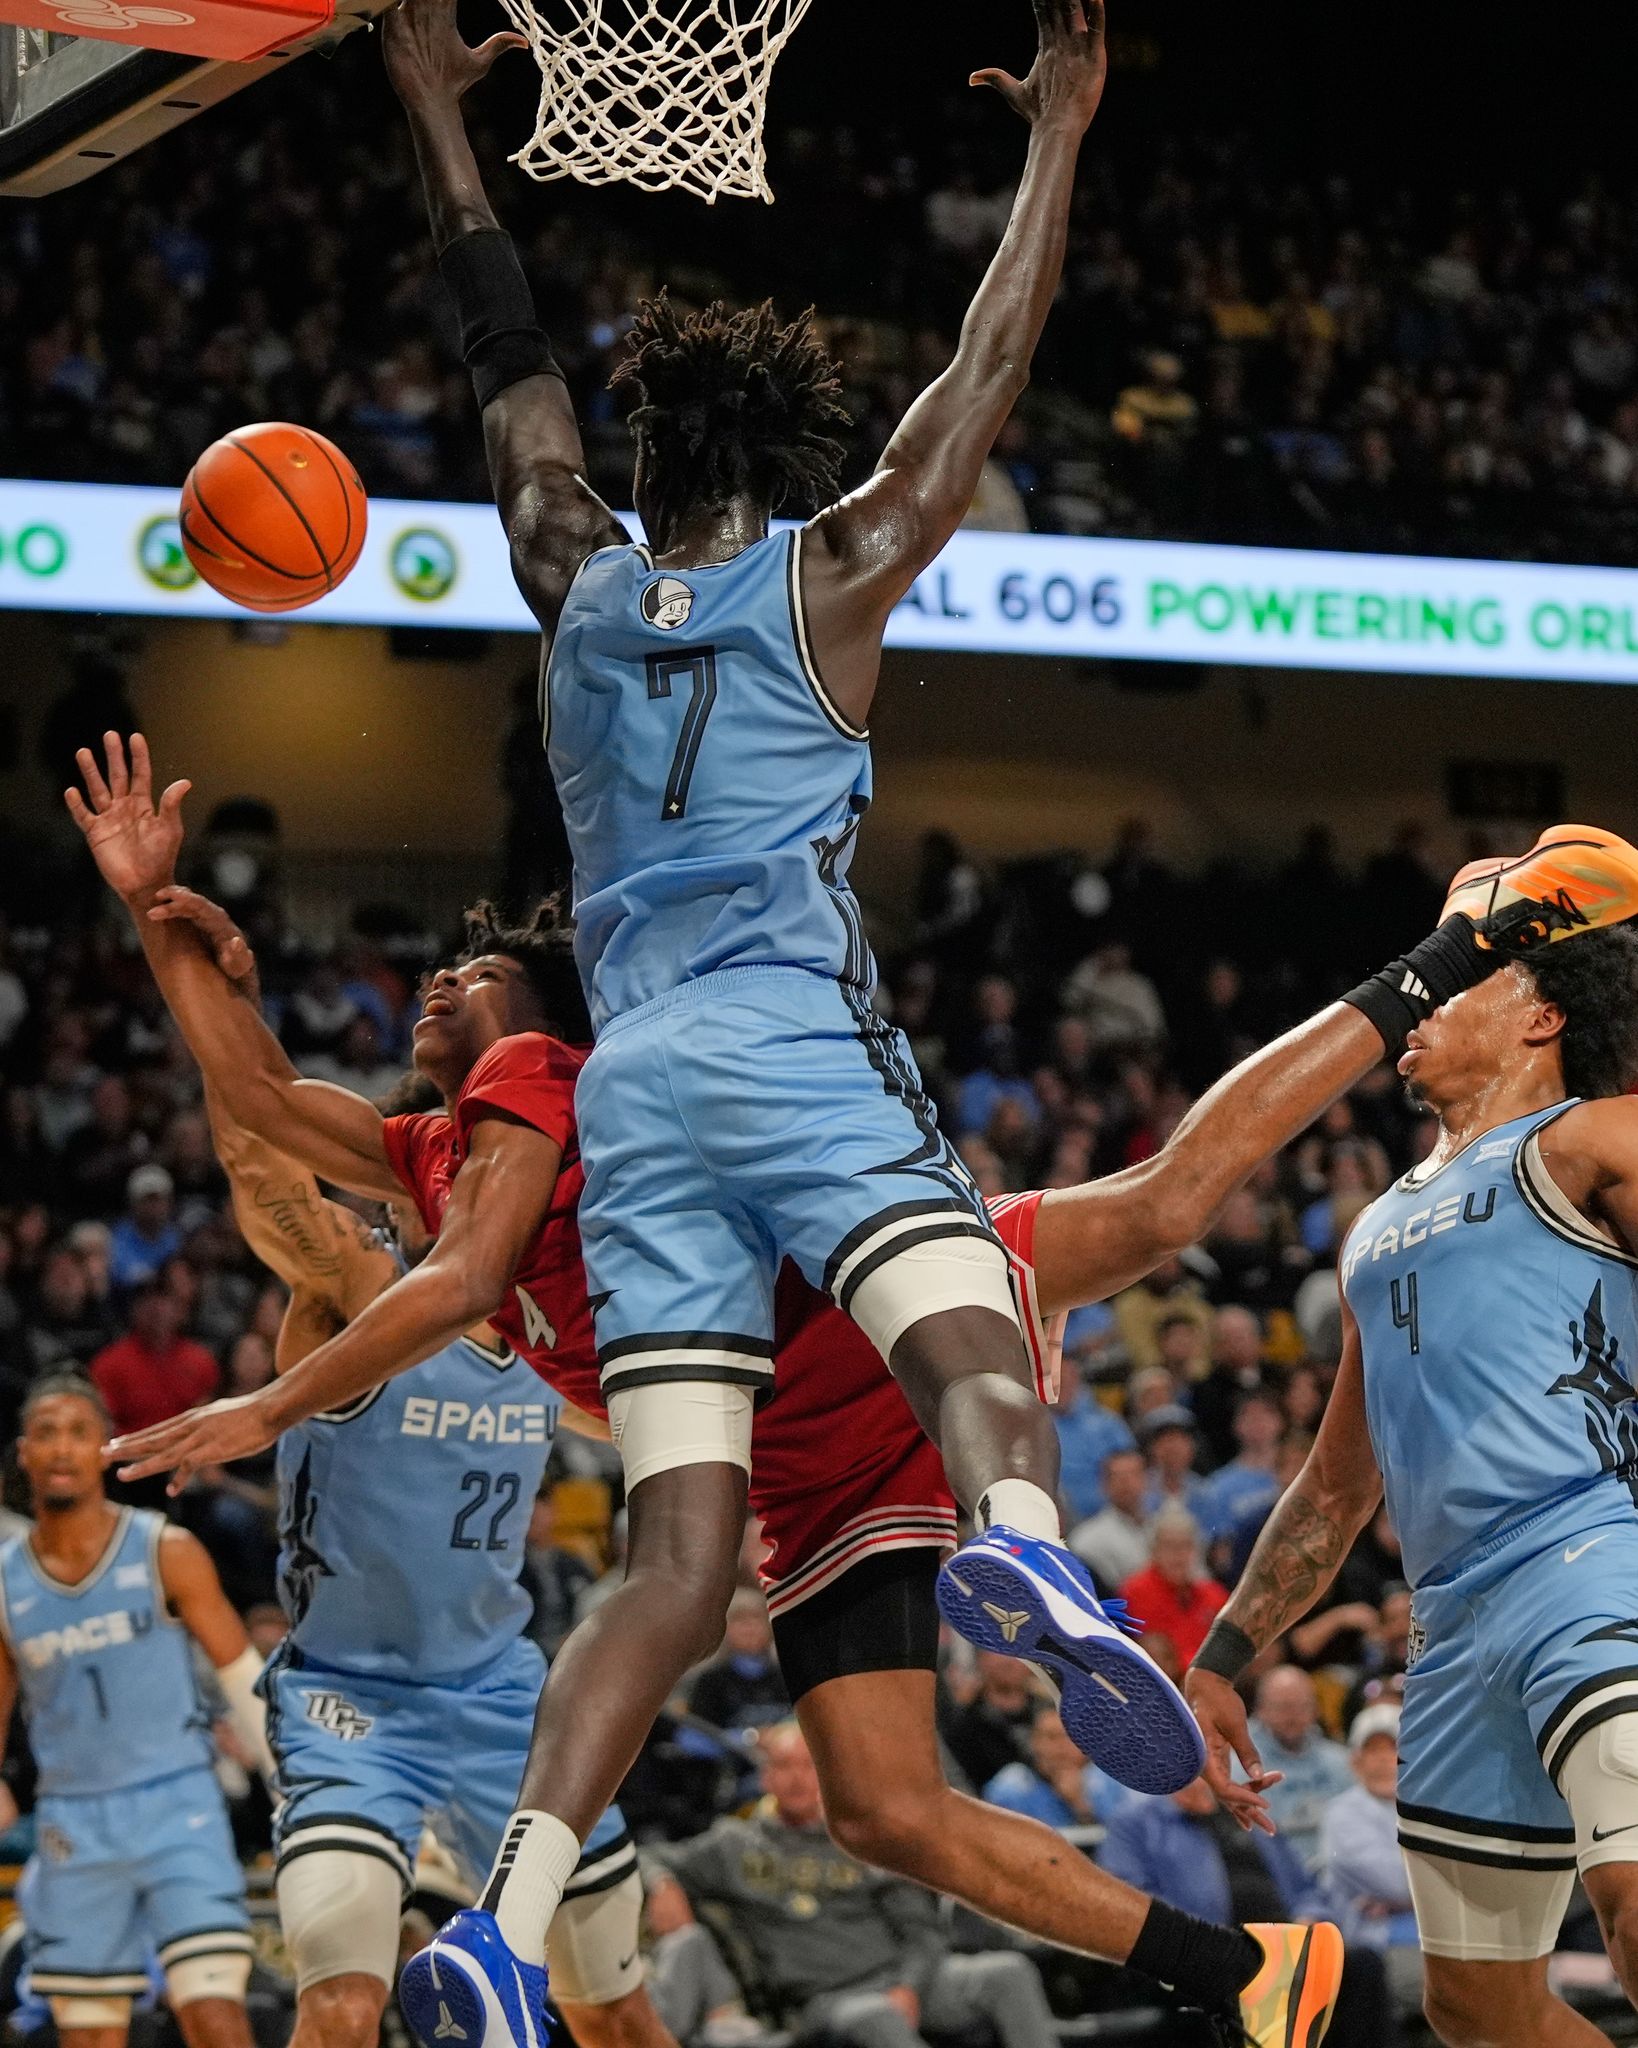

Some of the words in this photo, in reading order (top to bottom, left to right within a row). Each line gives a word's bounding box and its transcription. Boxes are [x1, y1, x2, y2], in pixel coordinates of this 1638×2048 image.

[0, 522, 67, 577] O
[998, 573, 1121, 626] 606
[1149, 581, 1505, 647] POWERING
[1529, 601, 1638, 654] ORL
[645, 645, 717, 821] 7
[1390, 1271, 1419, 1356] 4
[451, 1469, 521, 1551] 22
[85, 1664, 110, 1719] 1
[299, 1689, 375, 1743] UCF
